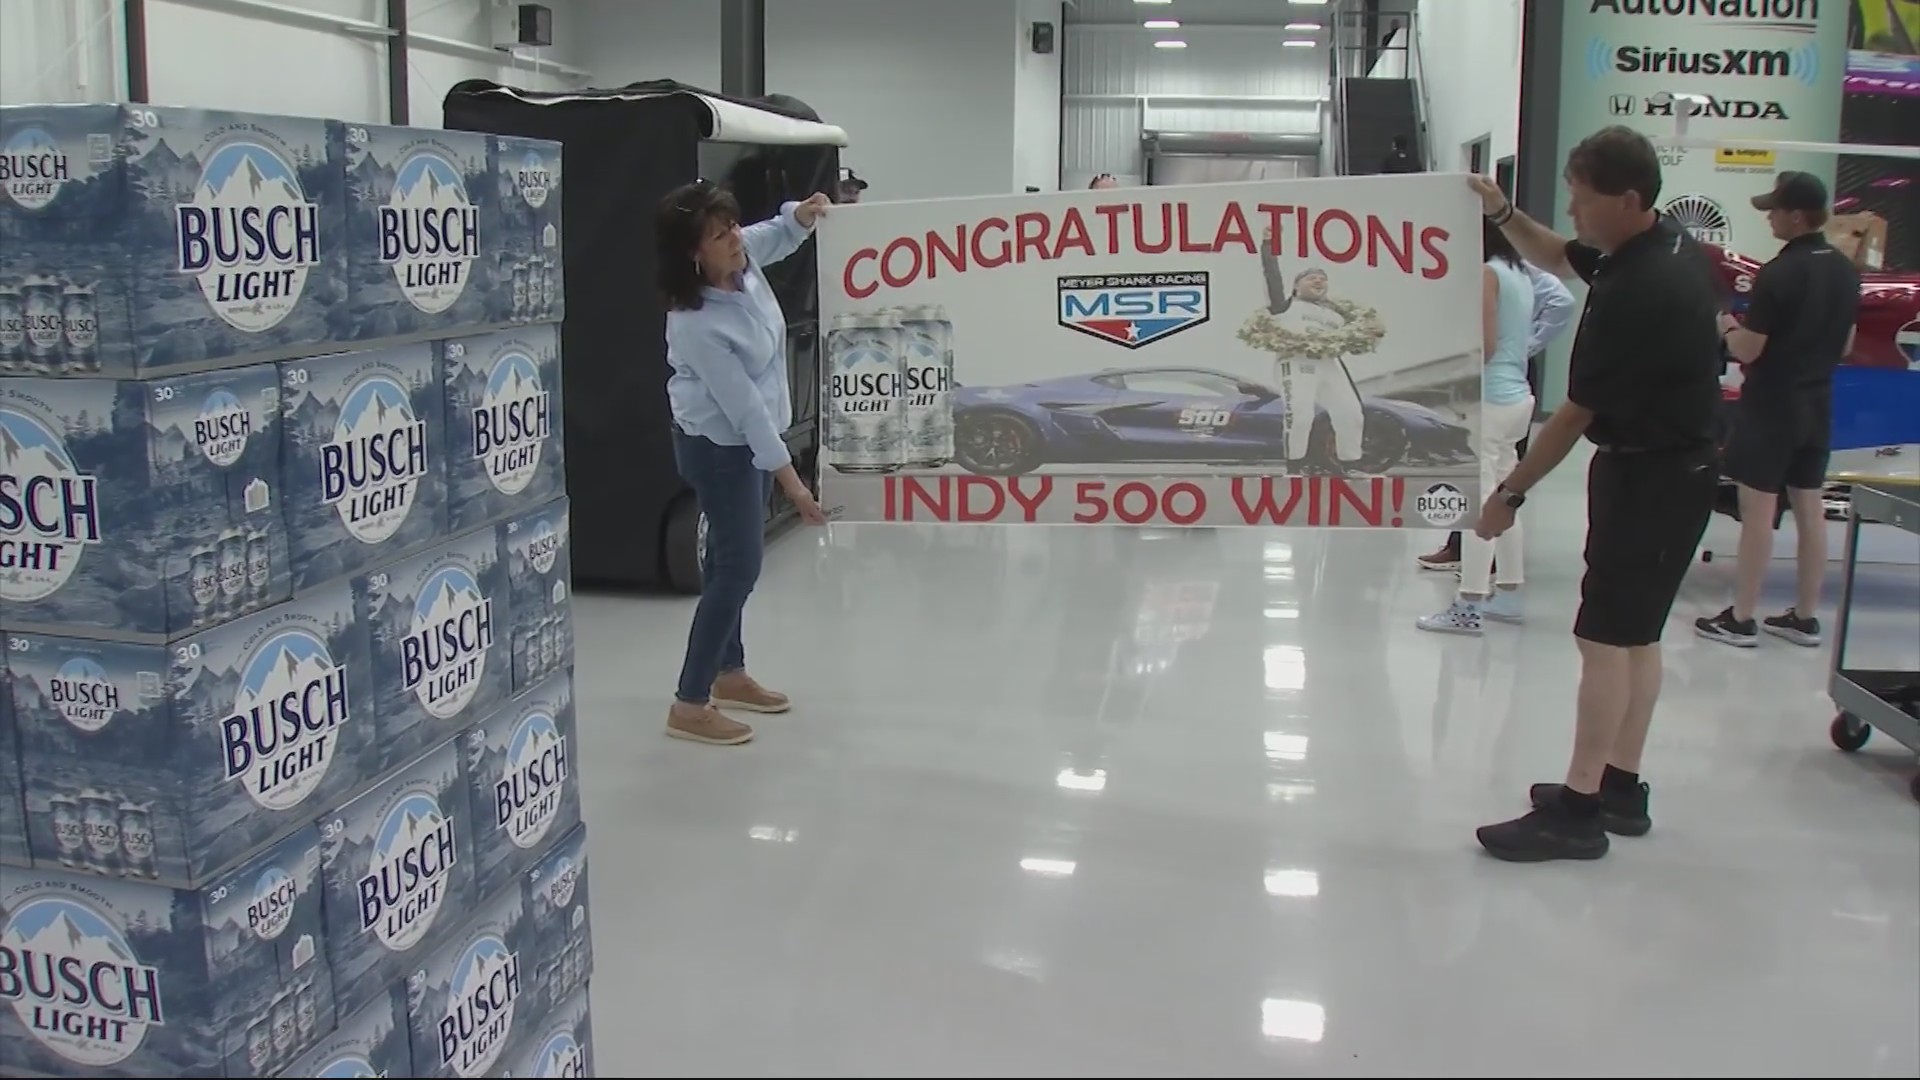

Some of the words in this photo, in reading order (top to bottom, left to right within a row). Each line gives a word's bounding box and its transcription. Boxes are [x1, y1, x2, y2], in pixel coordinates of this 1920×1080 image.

[131, 111, 158, 127] 30
[1644, 93, 1790, 119] HNDA
[229, 123, 248, 131] AND
[348, 128, 367, 143] 30
[0, 154, 67, 181] BUSCH
[519, 171, 550, 189] BUSCH
[13, 183, 53, 195] LIGHT
[179, 205, 318, 270] BUSCH
[382, 207, 478, 260] BUSCH
[843, 201, 1450, 299] CONGRATULATIONS
[216, 270, 295, 302] LIGHT
[406, 262, 462, 288] LIGHT
[1060, 277, 1104, 288] MEYER
[1107, 275, 1152, 286] SHANK
[1155, 273, 1206, 285] RACING
[1066, 291, 1201, 317] MSR
[449, 344, 463, 358] 30
[287, 368, 306, 385] 30
[832, 373, 902, 398] BUSCH
[907, 367, 948, 392] SCH
[154, 387, 174, 402] 30
[844, 400, 891, 412] LIGHT
[195, 411, 250, 446] BUSCH
[474, 393, 548, 457] BUSCH
[1178, 409, 1231, 426] 500
[209, 438, 241, 456] LIGHT
[494, 443, 536, 476] LIGHT
[322, 423, 425, 501] BUSCH
[0, 474, 98, 541] SCH
[350, 483, 408, 522] LIGHT
[884, 476, 1053, 522] INDY
[1073, 482, 1206, 524] 500
[1231, 476, 1404, 527] WIN!
[1417, 497, 1467, 512] BUSCH
[0, 541, 63, 571] GHT
[529, 533, 558, 560] BUSCH
[370, 574, 387, 590] 30
[10, 638, 29, 652] 30
[243, 628, 263, 651] COLD
[266, 617, 282, 629] AND
[403, 602, 493, 688] BUSCH
[176, 643, 200, 664] 30
[50, 679, 118, 708] BUSCH
[428, 658, 477, 703] LIGHT
[66, 706, 106, 720] LIGHT
[223, 669, 347, 778] BUSCH
[471, 730, 484, 743] 30
[259, 736, 327, 793] LIGHT
[495, 739, 567, 826] BUSCH
[515, 791, 555, 836] LIGHT
[324, 819, 344, 838] 30
[14, 882, 42, 896] COLD
[46, 880, 66, 889] AND
[360, 820, 455, 930] BUSCH
[210, 886, 227, 904] 30
[247, 879, 297, 928] BUSCH
[260, 909, 289, 934] LIGHT
[387, 880, 440, 938] LIGHT
[0, 946, 162, 1022] BUSCH
[412, 970, 426, 990] 30
[440, 956, 519, 1064] BUSCH
[34, 1007, 128, 1043] LIGHT
[463, 1012, 508, 1069] LIGHT
